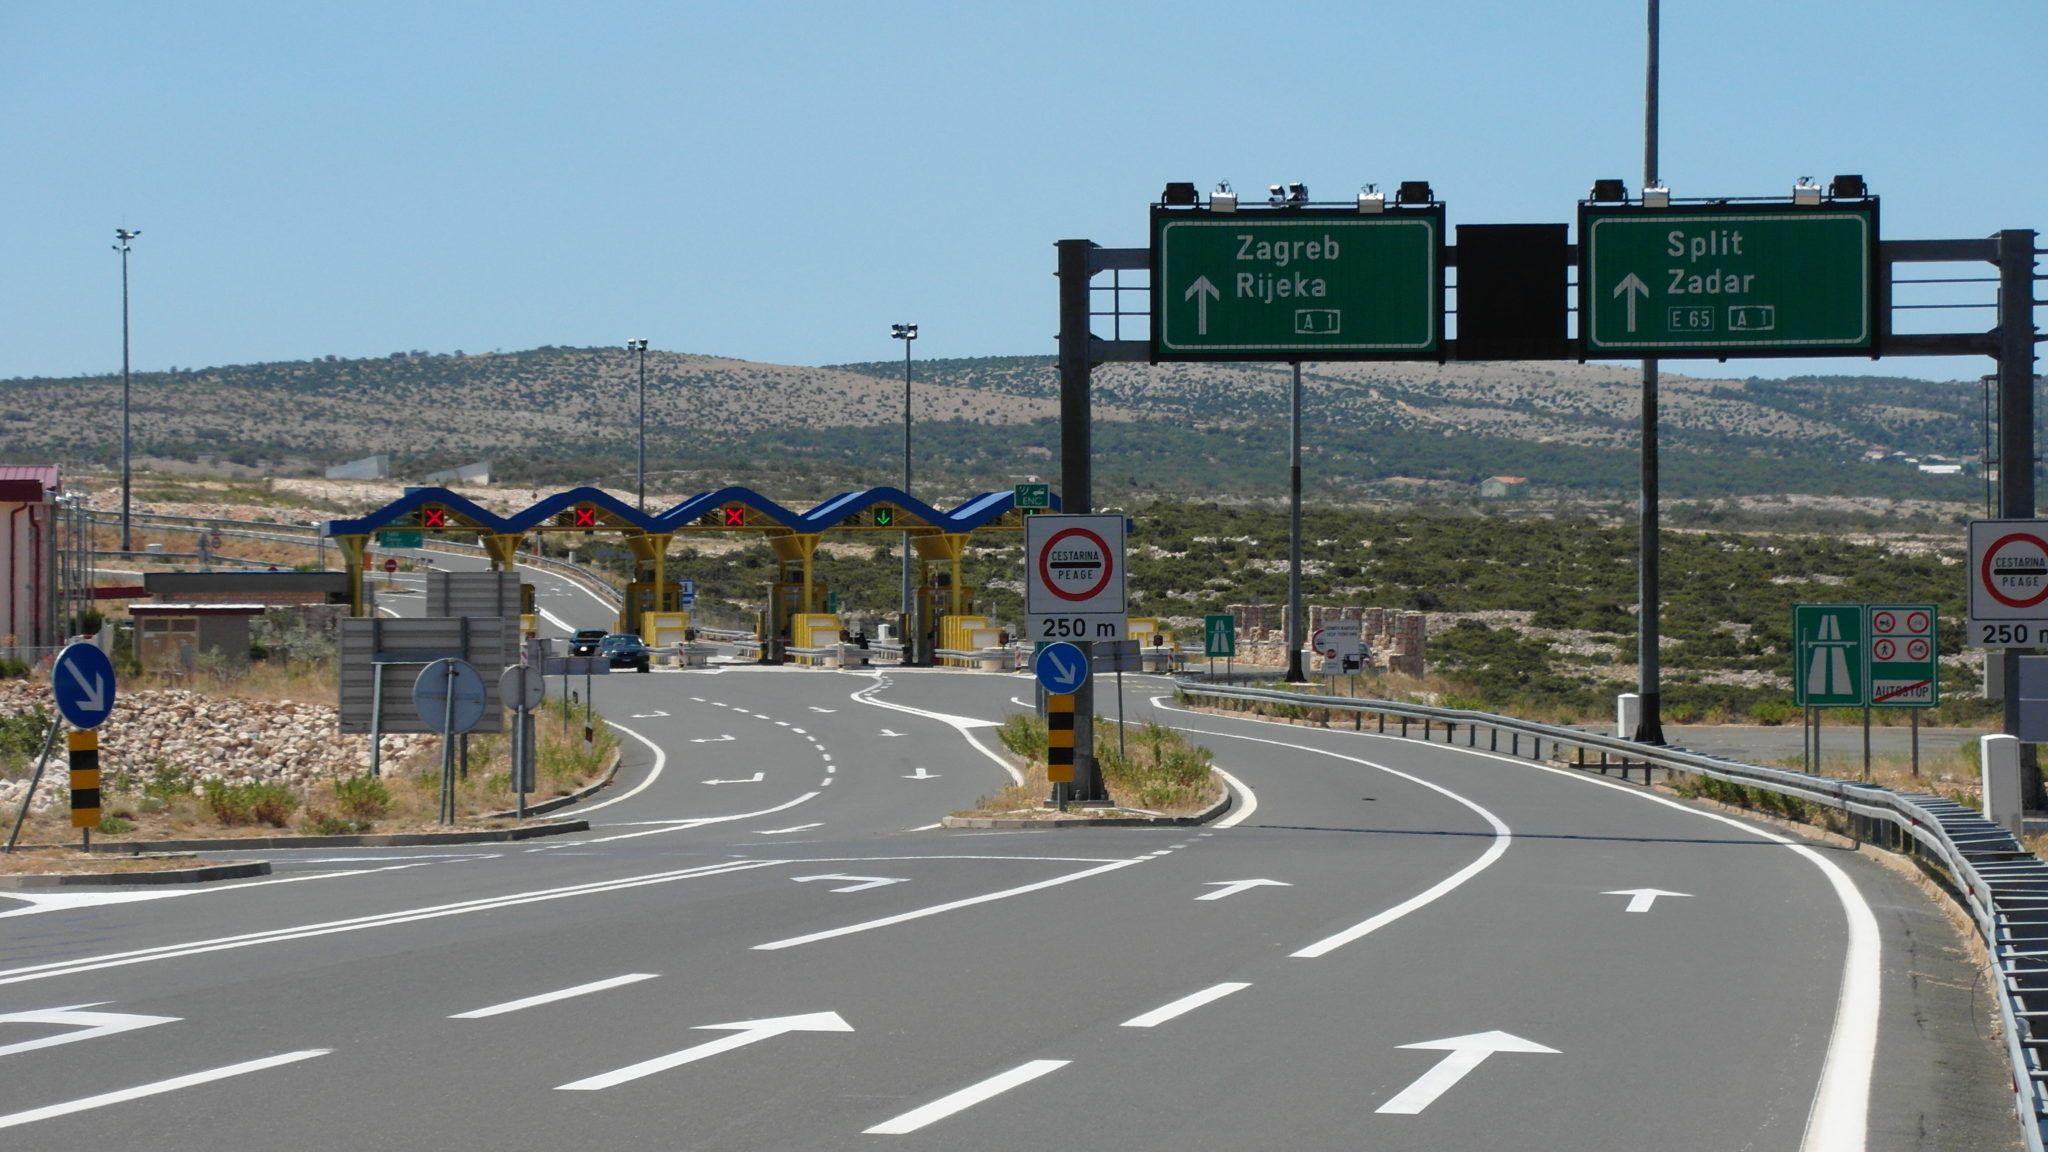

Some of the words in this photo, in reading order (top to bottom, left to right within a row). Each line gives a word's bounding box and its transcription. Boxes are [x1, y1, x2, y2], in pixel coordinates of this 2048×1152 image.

[1236, 235, 1340, 267] Zagreb
[1667, 230, 1743, 263] Split
[1236, 272, 1326, 304] Rijeka
[1667, 269, 1755, 294] Zadar
[1672, 311, 1681, 327] E
[1689, 311, 1710, 327] 65
[1022, 496, 1043, 506] ENC
[1052, 551, 1099, 561] CESTARINA
[1996, 557, 2046, 568] CESTARINA
[1058, 570, 1093, 580] PEAGE
[2002, 576, 2040, 587] PEAGE
[1043, 618, 1086, 637] 250
[1096, 623, 1115, 637] m
[1982, 624, 2028, 644] 250
[1875, 685, 1929, 698] AUTOSTOP
